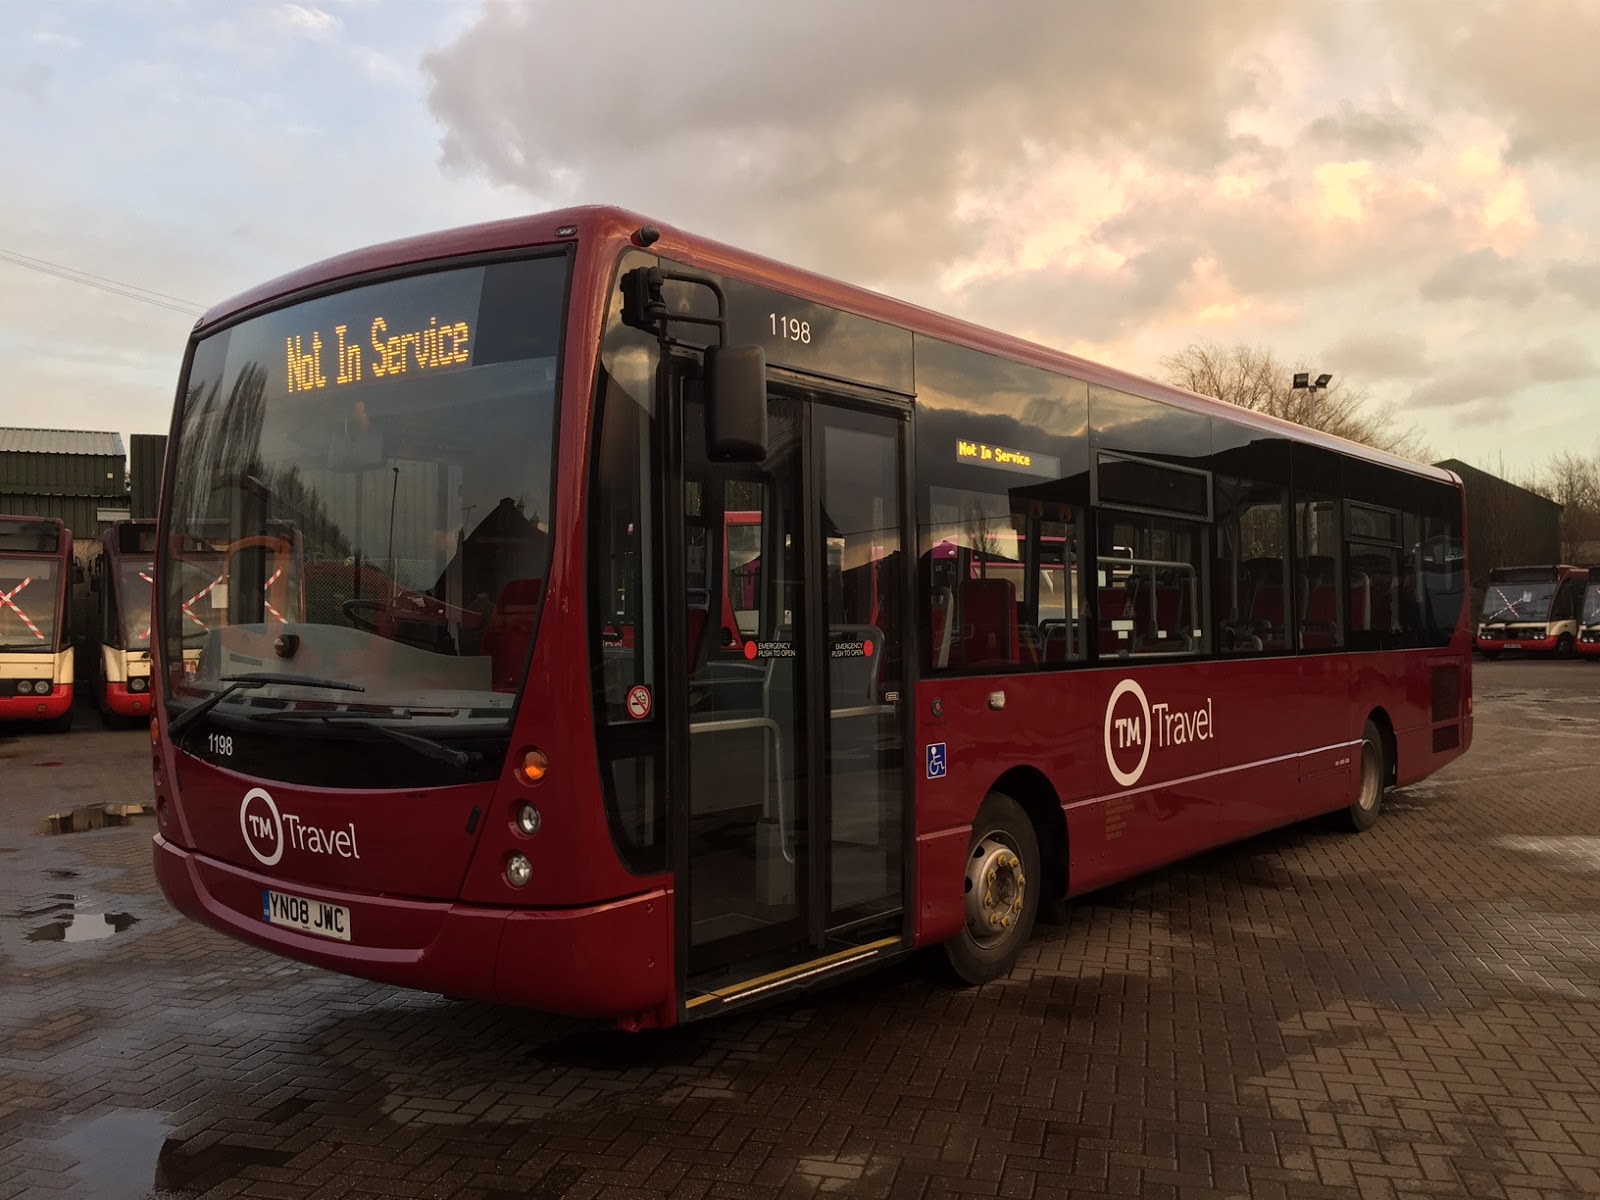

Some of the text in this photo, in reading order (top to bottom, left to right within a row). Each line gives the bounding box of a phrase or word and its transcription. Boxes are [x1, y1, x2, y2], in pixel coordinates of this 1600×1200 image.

[769, 313, 812, 344] 1198
[286, 316, 470, 393] Not In Service
[958, 439, 1031, 467] Not In Service
[781, 649, 796, 657] OPEN
[831, 650, 844, 658] PUSH
[851, 649, 864, 657] OPEN
[1115, 697, 1214, 749] TM Travel
[208, 733, 233, 757] 1198
[249, 813, 361, 860] TM Travel
[270, 893, 344, 932] YN08 JWC
